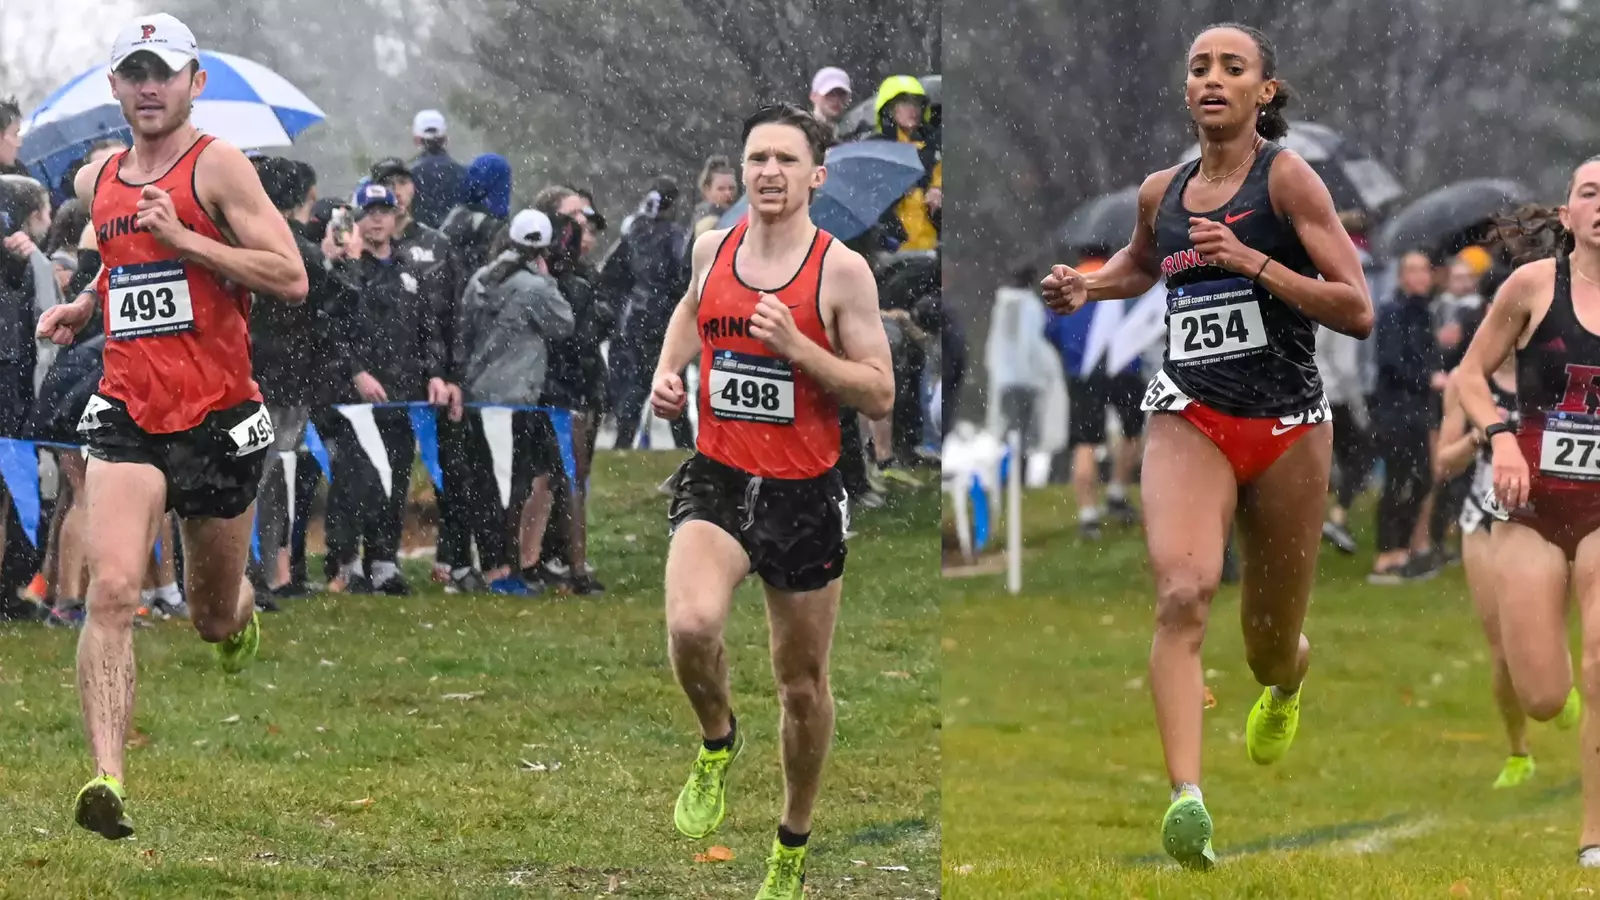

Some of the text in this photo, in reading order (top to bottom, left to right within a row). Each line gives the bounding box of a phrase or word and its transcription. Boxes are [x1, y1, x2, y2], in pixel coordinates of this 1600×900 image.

[141, 24, 156, 39] P
[120, 287, 176, 322] 493
[1191, 294, 1212, 304] COUNTRY
[1213, 288, 1253, 300] CHAMPIONSHIPS
[1181, 309, 1249, 352] 254
[721, 378, 780, 411] 498
